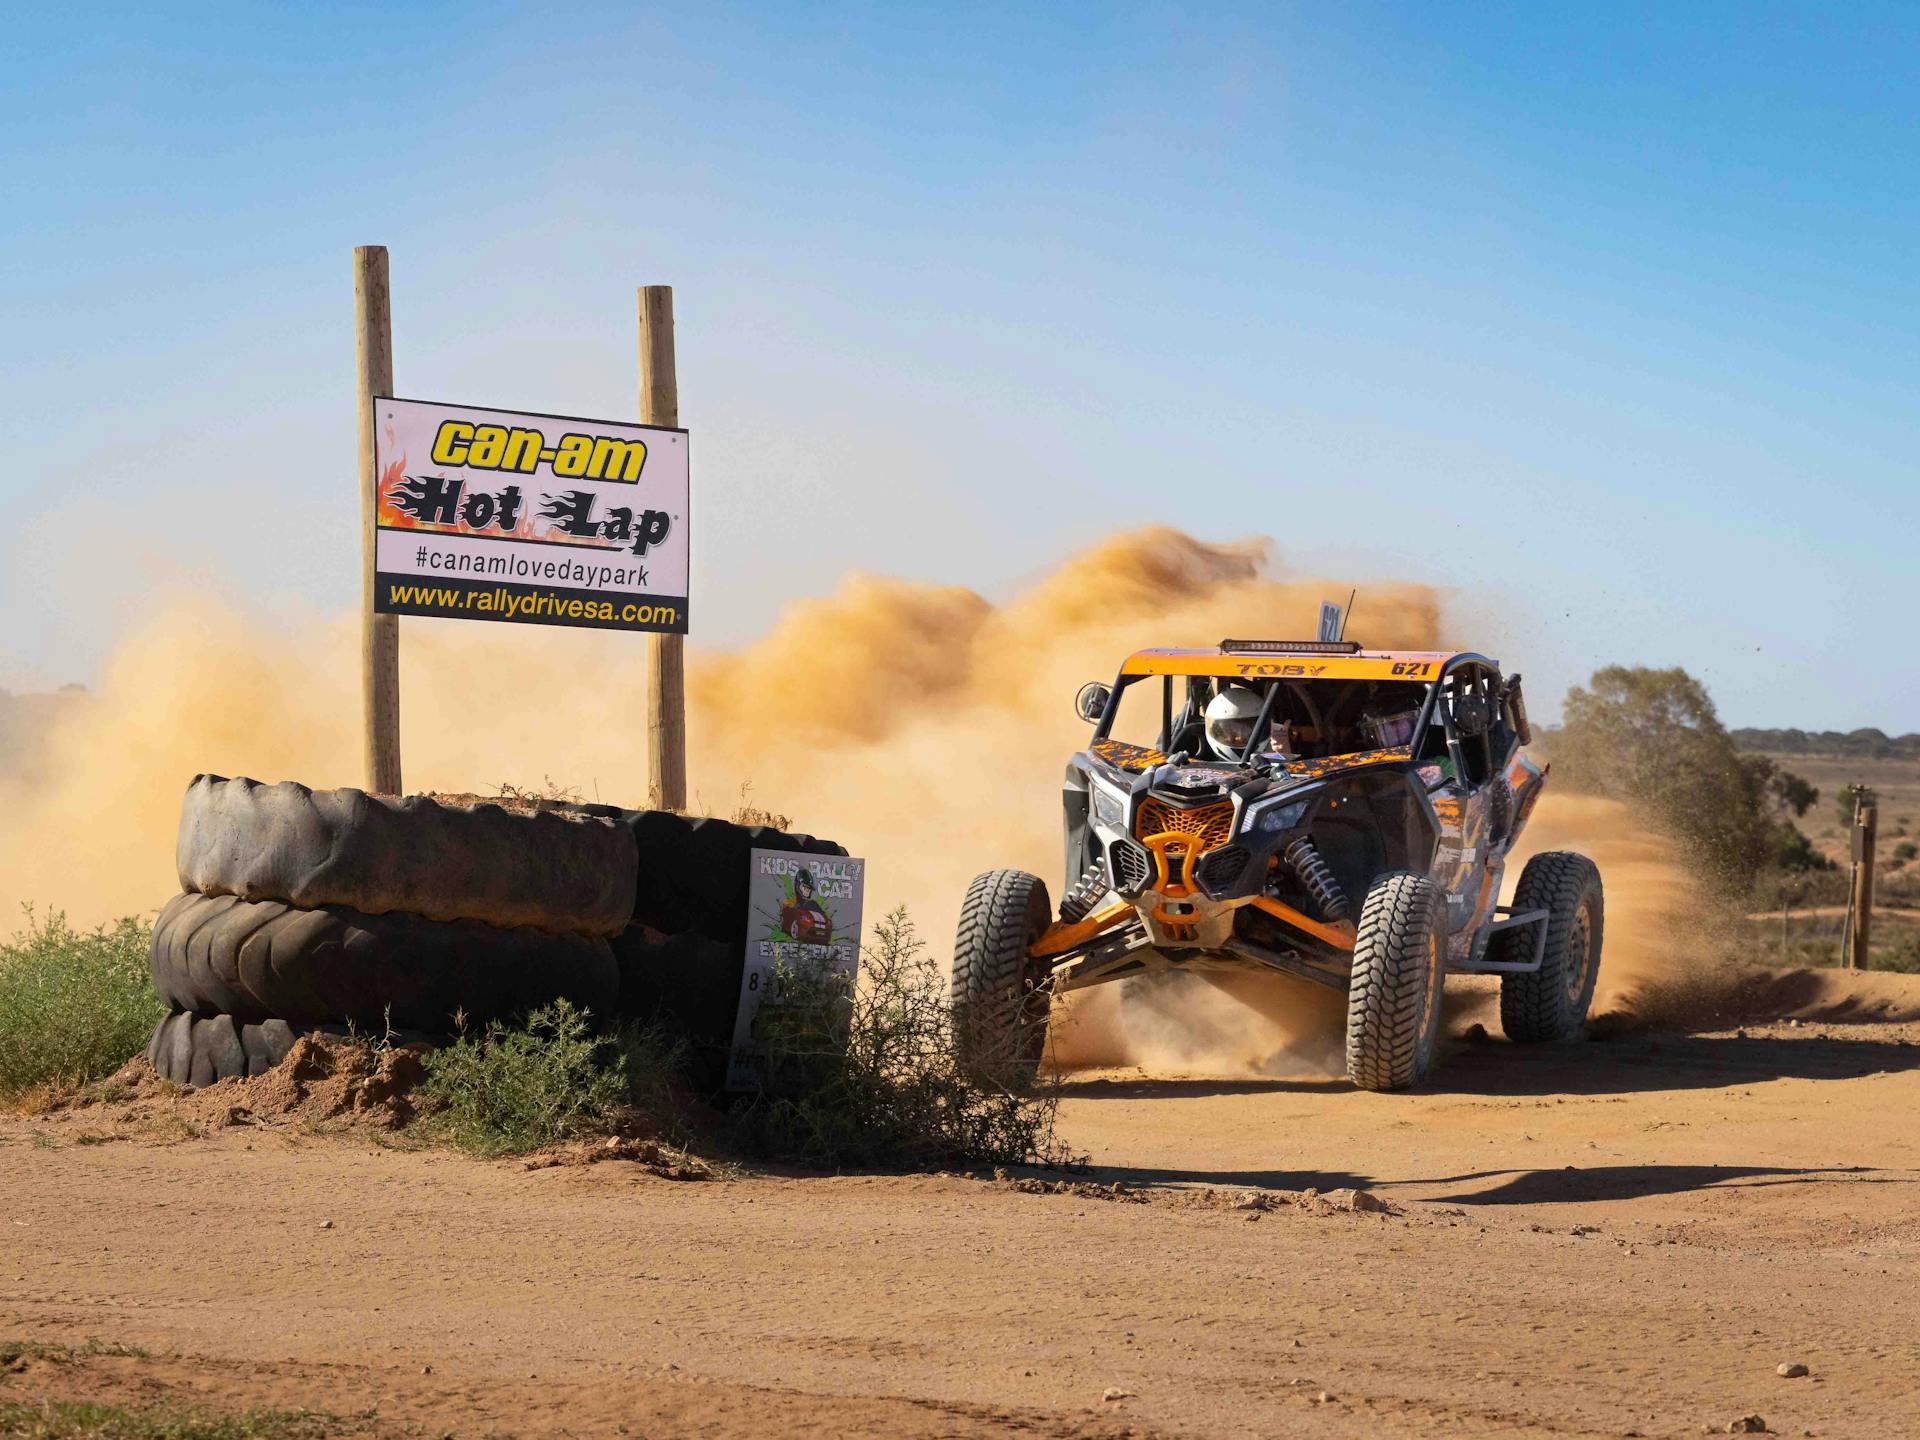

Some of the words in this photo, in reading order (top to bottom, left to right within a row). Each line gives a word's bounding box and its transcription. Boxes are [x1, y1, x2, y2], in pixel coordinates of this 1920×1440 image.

[431, 419, 648, 485] can-am
[384, 475, 522, 532] Hot
[535, 490, 671, 557] Lap
[416, 546, 649, 587] #canamlovedaypark
[390, 585, 676, 625] www.rallydrivesa.com
[1236, 663, 1328, 677] TOBY
[1391, 662, 1431, 676] 621
[760, 856, 800, 877] KIDS
[808, 861, 862, 881] RALLY
[818, 879, 854, 899] CAR
